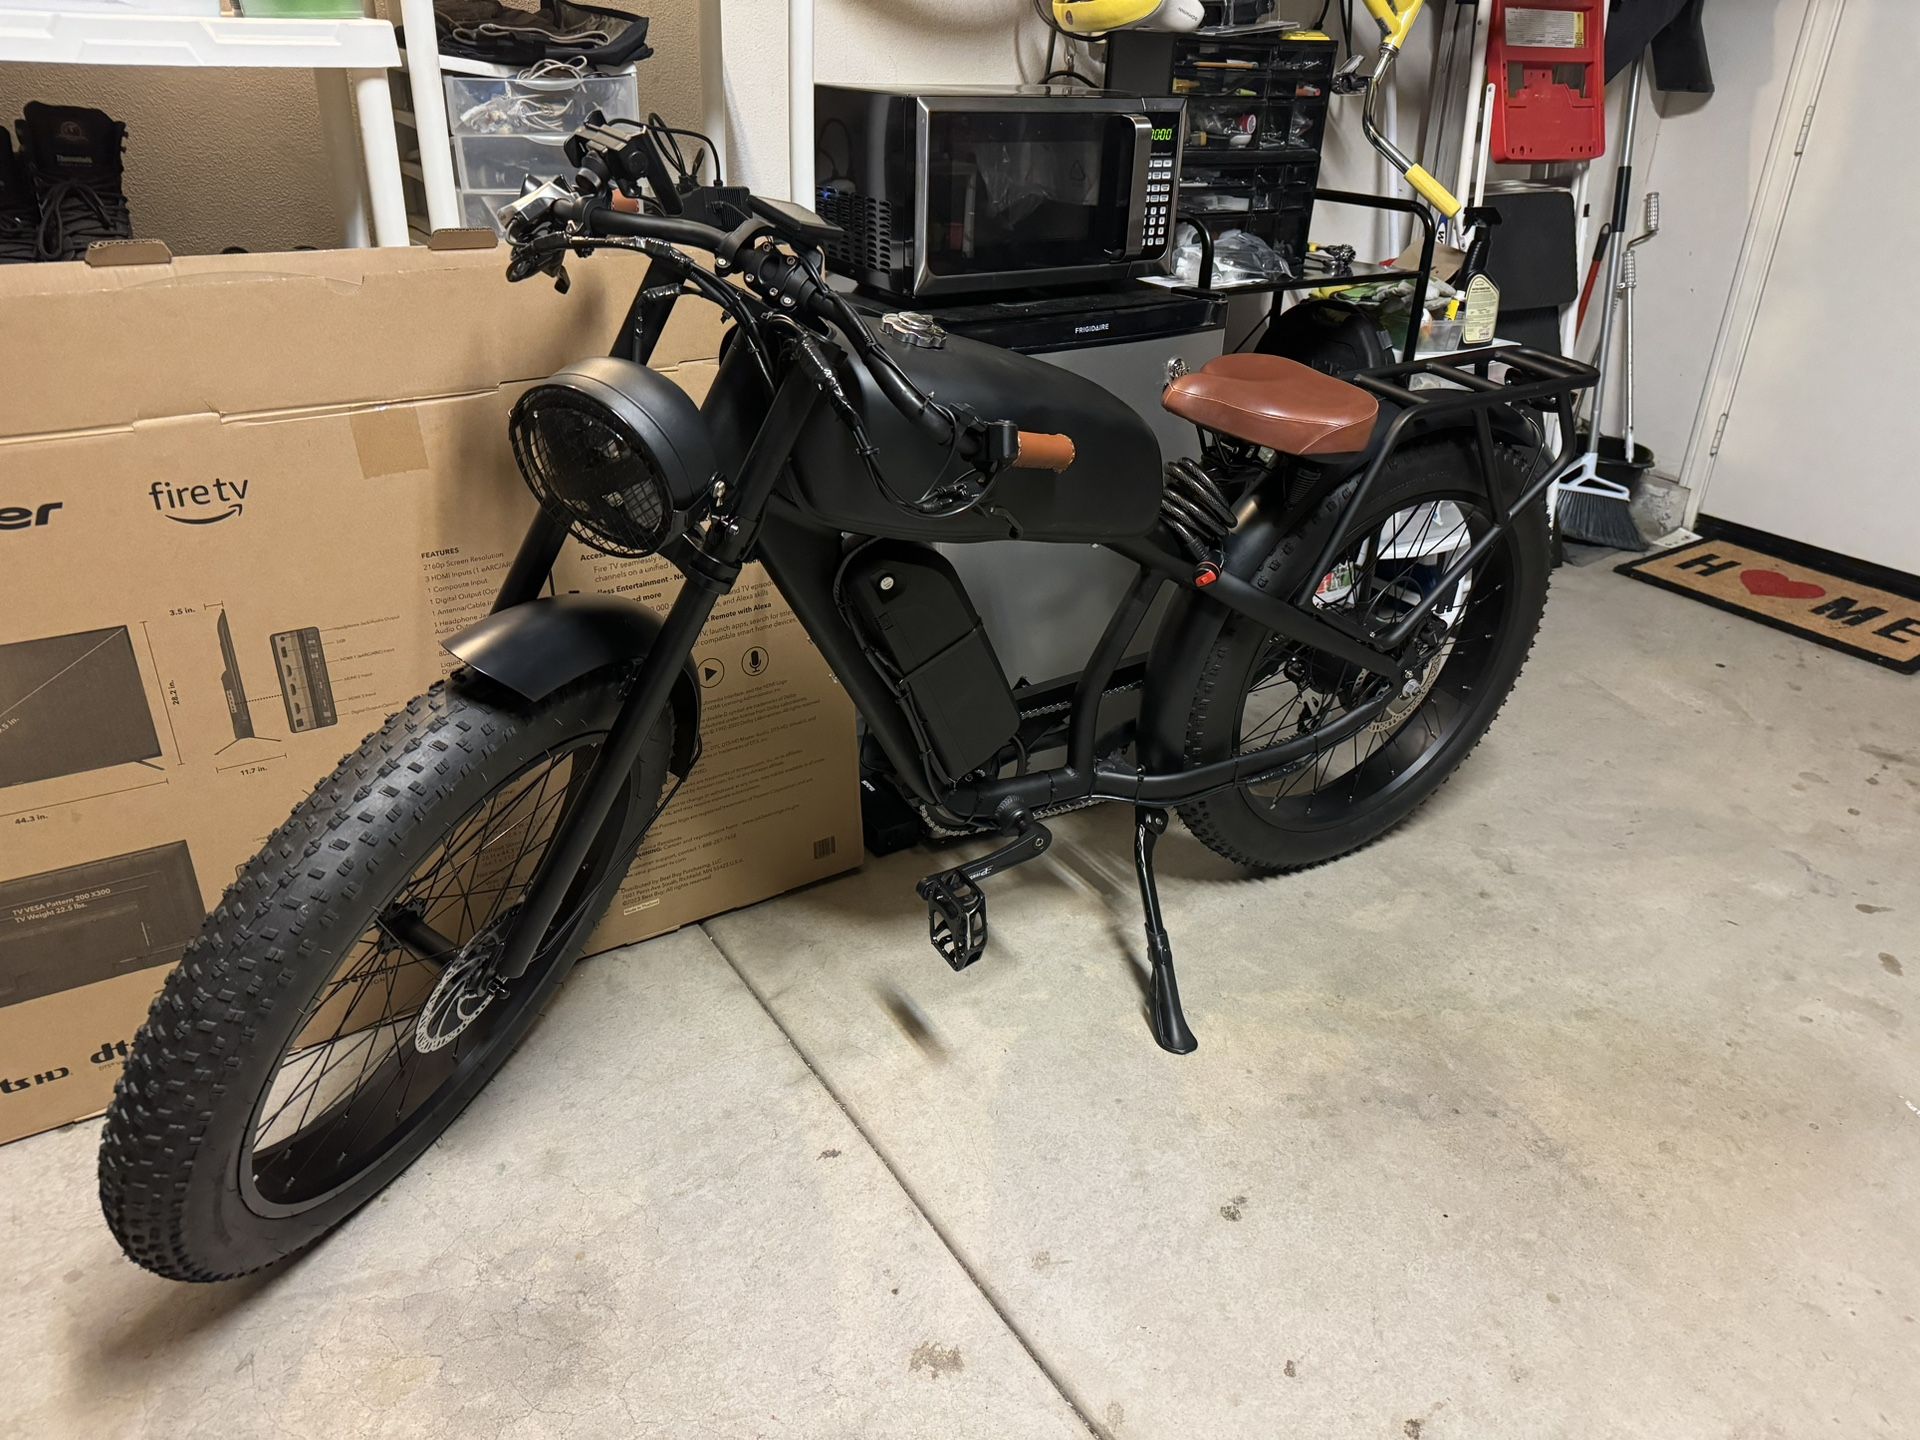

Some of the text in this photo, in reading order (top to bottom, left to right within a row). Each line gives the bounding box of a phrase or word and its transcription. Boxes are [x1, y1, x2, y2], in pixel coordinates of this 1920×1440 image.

[1074, 323, 1110, 334] FRIGIDAIRE
[420, 546, 460, 559] FEATURES
[423, 552, 504, 571] 2160p Screen Resolution
[593, 565, 608, 574] Fire
[609, 562, 619, 570] TV
[620, 556, 658, 569] seamlessly
[431, 572, 452, 582] HDMI
[452, 568, 473, 578] Inputs
[594, 570, 627, 583] channels
[644, 562, 669, 573] unified
[433, 582, 470, 594] Composite
[470, 578, 488, 587] Input
[616, 577, 669, 593] Entertainment
[741, 585, 750, 593] TV
[435, 595, 457, 605] Digital
[458, 590, 482, 600] Output
[642, 591, 662, 602] more
[722, 598, 735, 606] and
[736, 594, 754, 603] Alexa
[754, 589, 769, 598] skills
[169, 606, 197, 616] 3.5 in.
[437, 601, 486, 616] Antenna/Cable
[710, 602, 772, 622] Remote with Alexa
[439, 614, 478, 627] Headphone
[709, 624, 731, 635] launch
[732, 621, 749, 631] apps,
[749, 615, 770, 625] search
[770, 613, 780, 621] for
[434, 626, 455, 635] Audio
[700, 632, 736, 646] compatible
[737, 628, 754, 637] smart
[755, 623, 773, 633] home
[167, 679, 180, 706] 28.2 in.
[240, 765, 268, 777] 11.7 in.
[15, 813, 49, 825] 44.3 in.
[12, 888, 111, 917] TV VESA Pattern 200 X300
[14, 902, 88, 924] TV Weight 22.5 lbs.
[34, 1067, 69, 1085] HD
